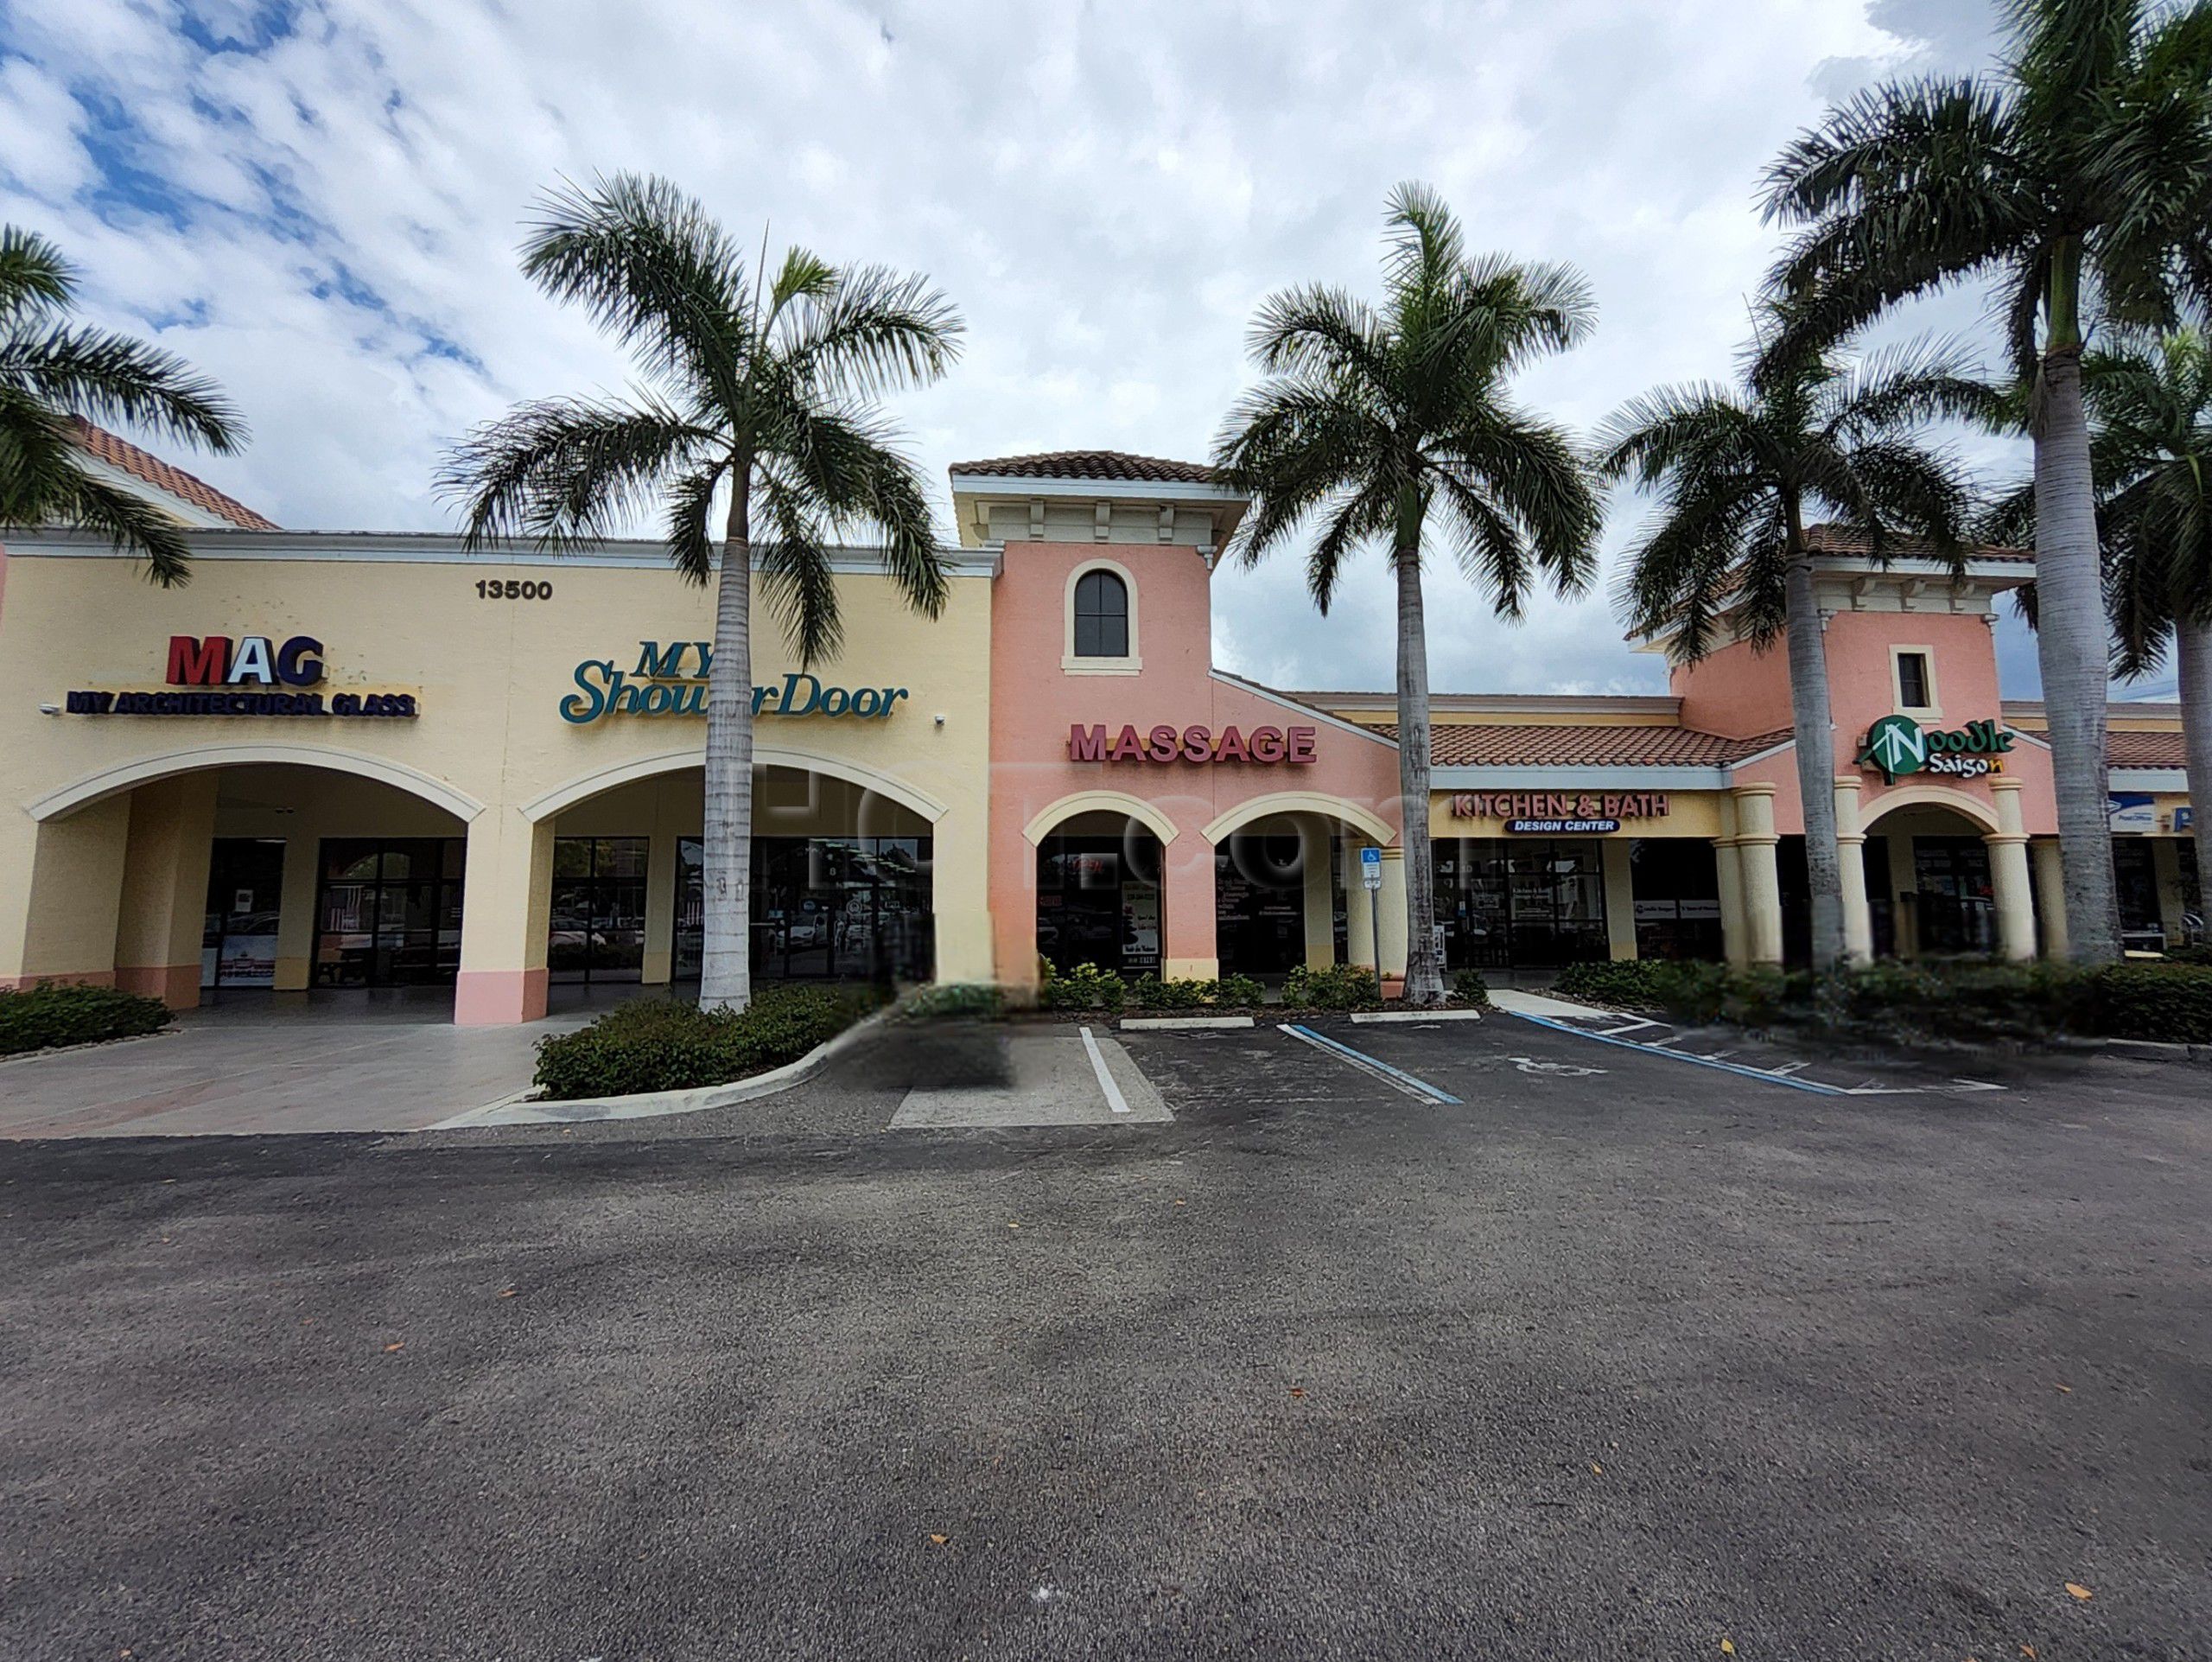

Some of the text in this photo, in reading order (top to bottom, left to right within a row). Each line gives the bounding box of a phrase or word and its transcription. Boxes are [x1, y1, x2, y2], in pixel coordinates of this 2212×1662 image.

[474, 579, 554, 601] 13500
[165, 635, 325, 687] MAG
[66, 691, 419, 717] MY ARCHITECTURAL GLASS
[1069, 723, 1318, 764] MASSAGE
[1929, 753, 2005, 778] Saigon
[1452, 793, 1670, 818] KITCHEN & BATH
[1514, 820, 1615, 831] DESIGN CENTER
